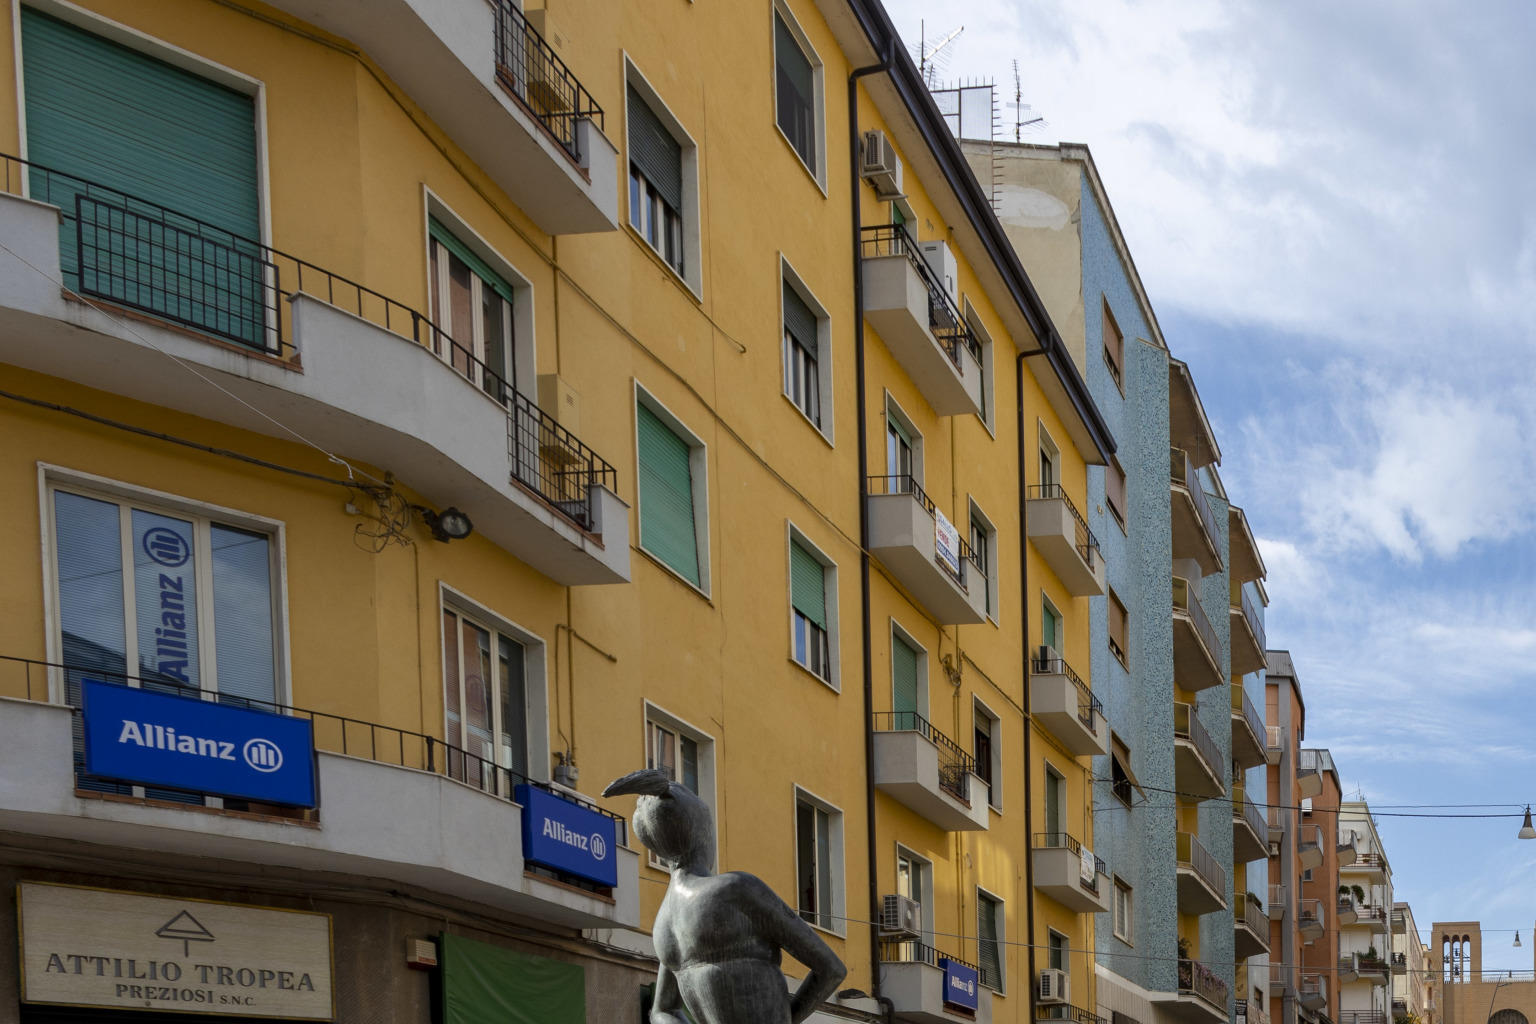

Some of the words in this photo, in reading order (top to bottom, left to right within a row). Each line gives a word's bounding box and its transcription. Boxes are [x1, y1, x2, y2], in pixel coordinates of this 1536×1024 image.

[155, 573, 190, 684] Allianz
[118, 719, 236, 761] Allianz
[543, 817, 588, 851] Allianz
[45, 953, 182, 982] ATTILIO
[194, 964, 316, 992] TROPEA
[951, 975, 968, 992] Allianz
[115, 984, 214, 1004] PREZIOSI
[219, 994, 257, 1007] S.N.C.
